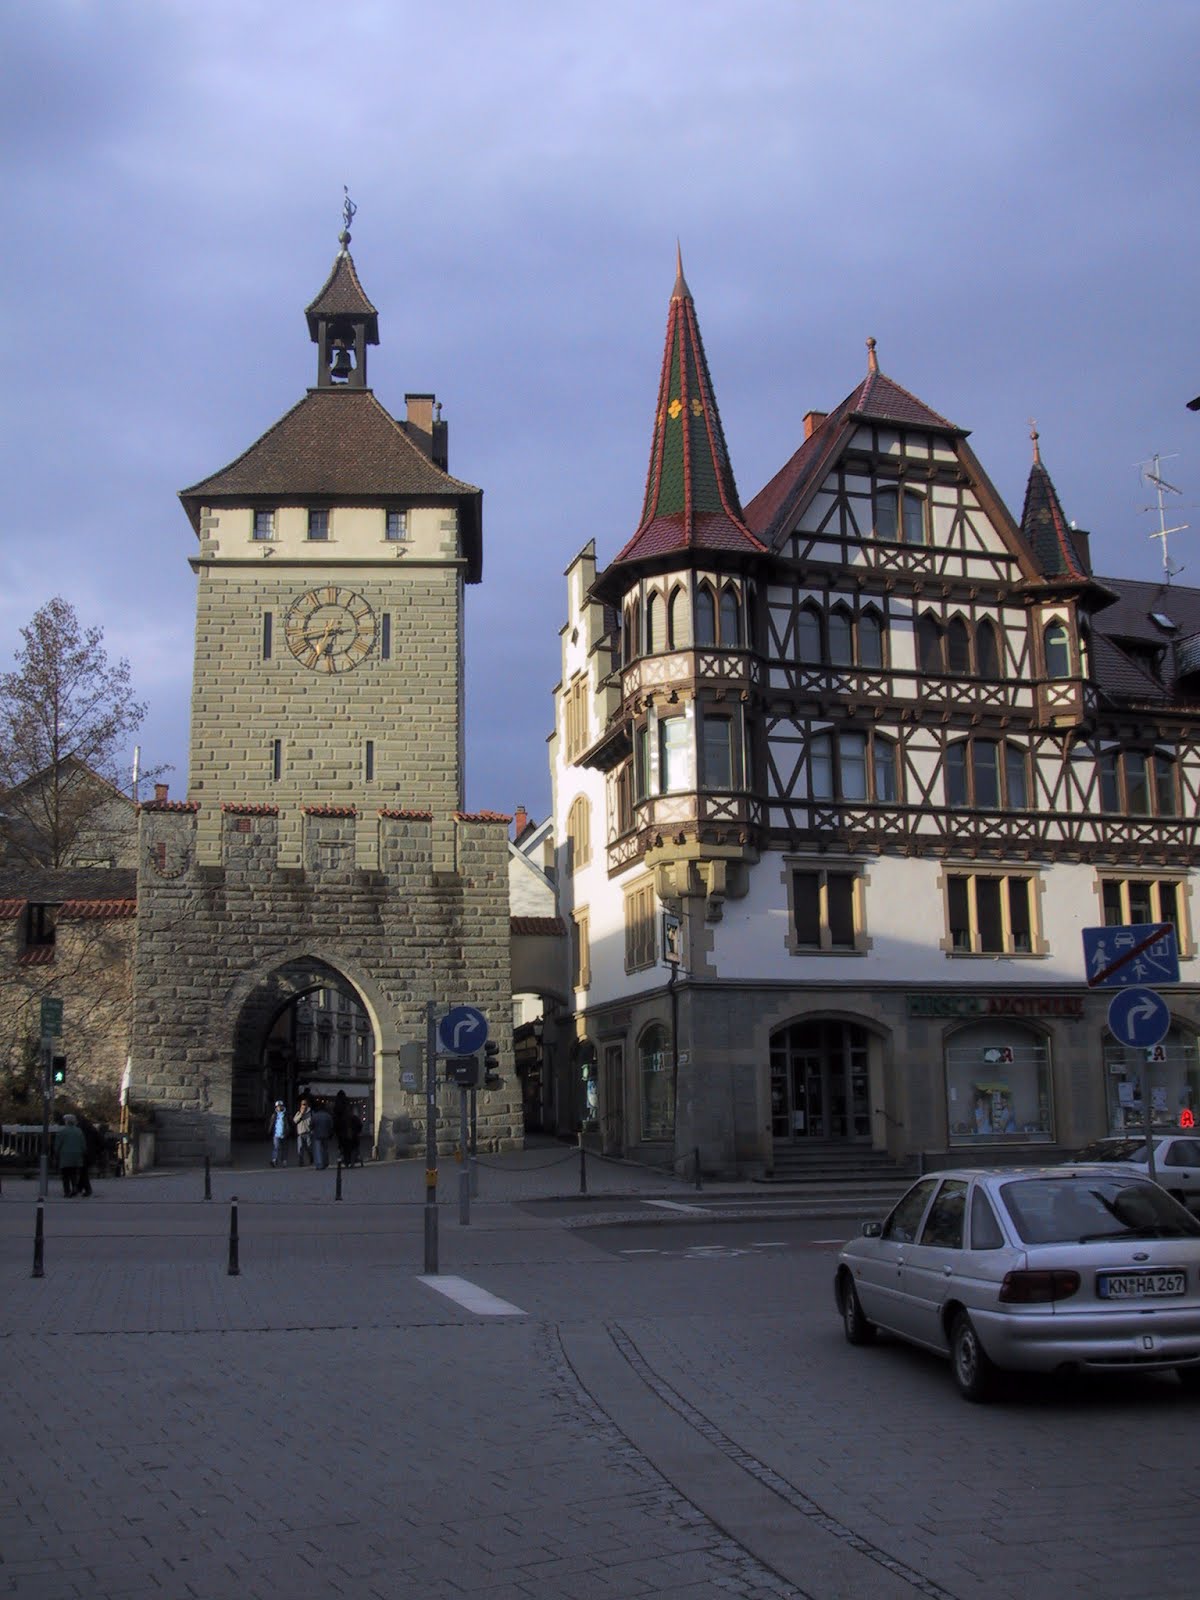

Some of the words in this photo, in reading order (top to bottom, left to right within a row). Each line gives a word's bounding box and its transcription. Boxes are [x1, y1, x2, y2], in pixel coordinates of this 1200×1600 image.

[1109, 1279, 1128, 1294] KN
[1137, 1278, 1155, 1293] HA
[1158, 1276, 1183, 1291] 267
[1143, 1335, 1153, 1349] D
